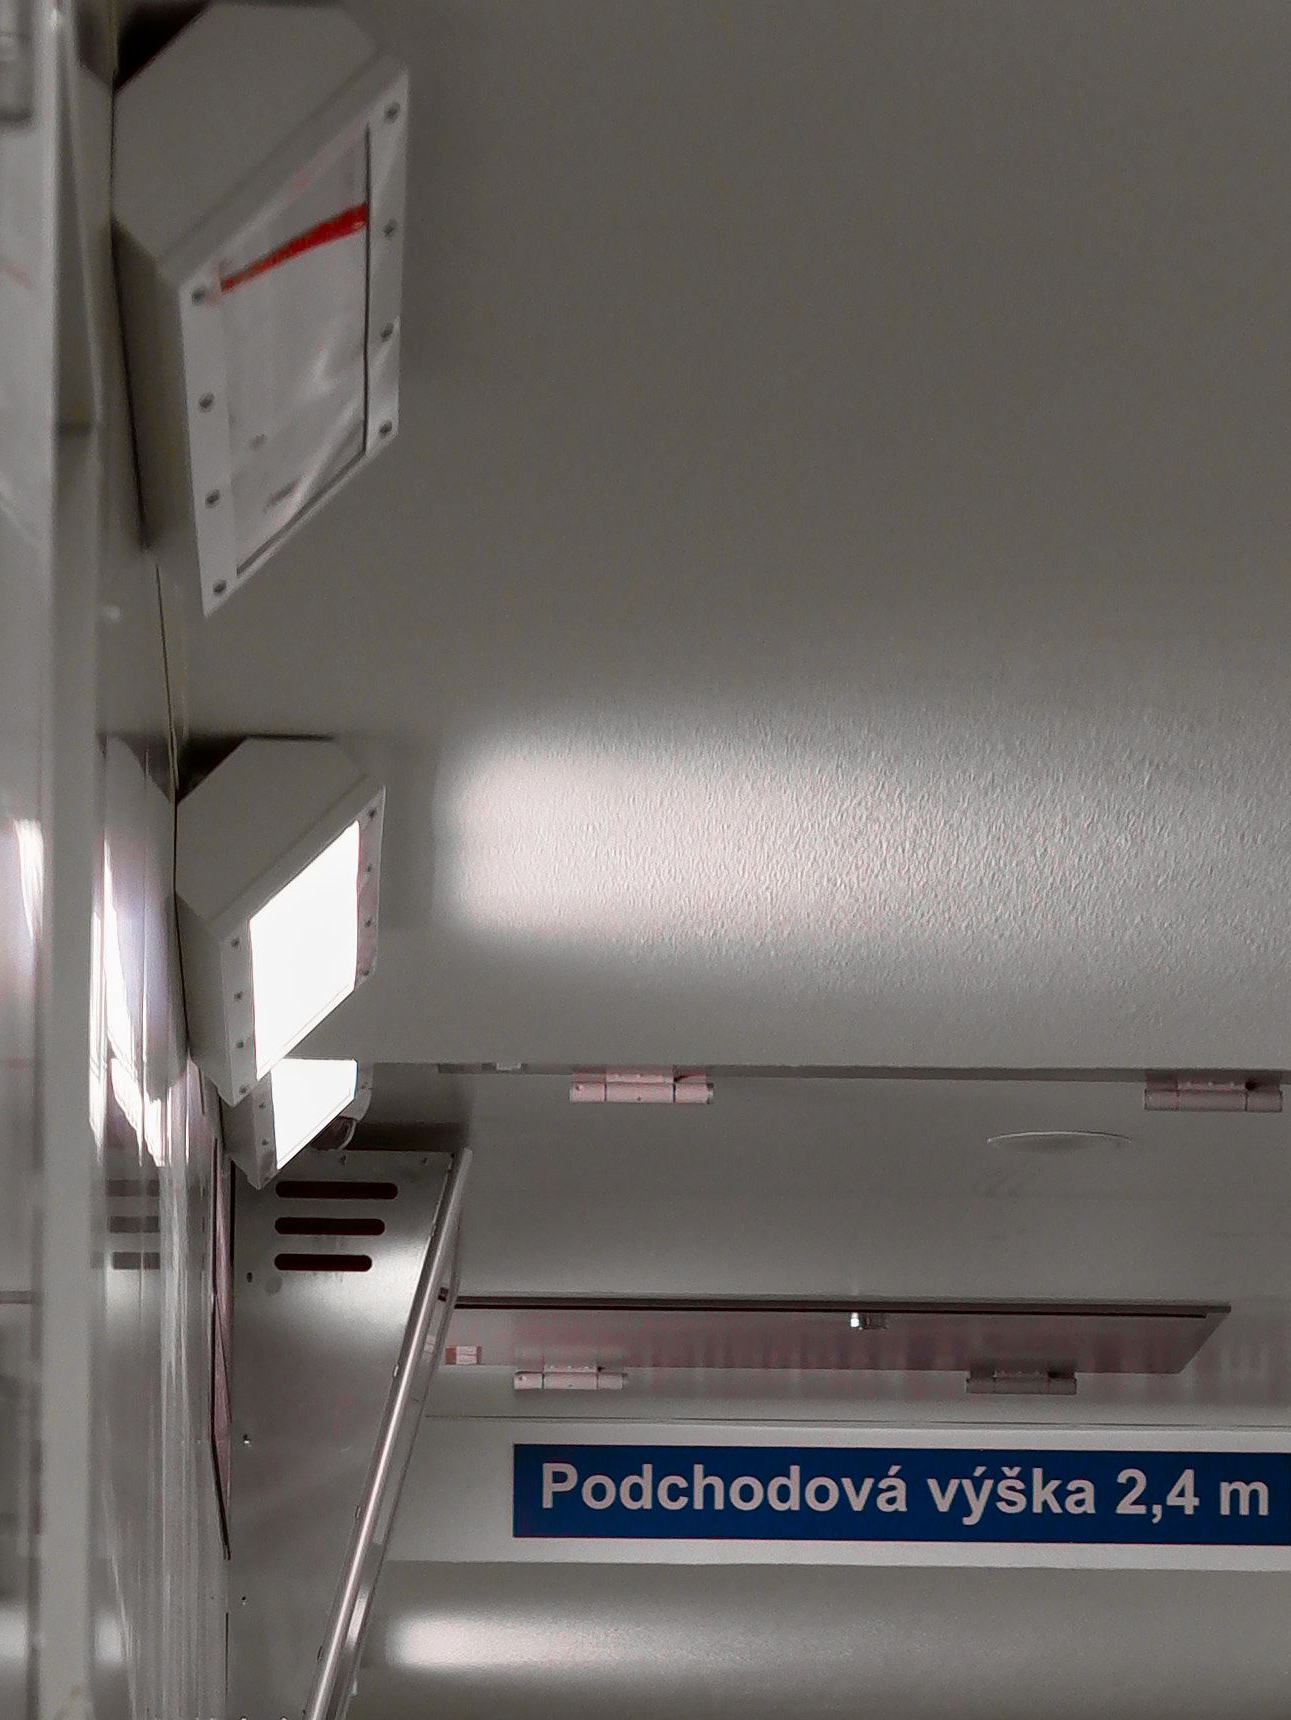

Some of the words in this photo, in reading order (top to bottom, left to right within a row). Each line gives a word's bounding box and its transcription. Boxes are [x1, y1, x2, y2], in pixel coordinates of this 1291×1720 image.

[542, 1461, 907, 1512] Podchodová
[927, 1466, 1096, 1526] výška
[1116, 1468, 1200, 1524] 2,4
[1220, 1481, 1269, 1516] m
